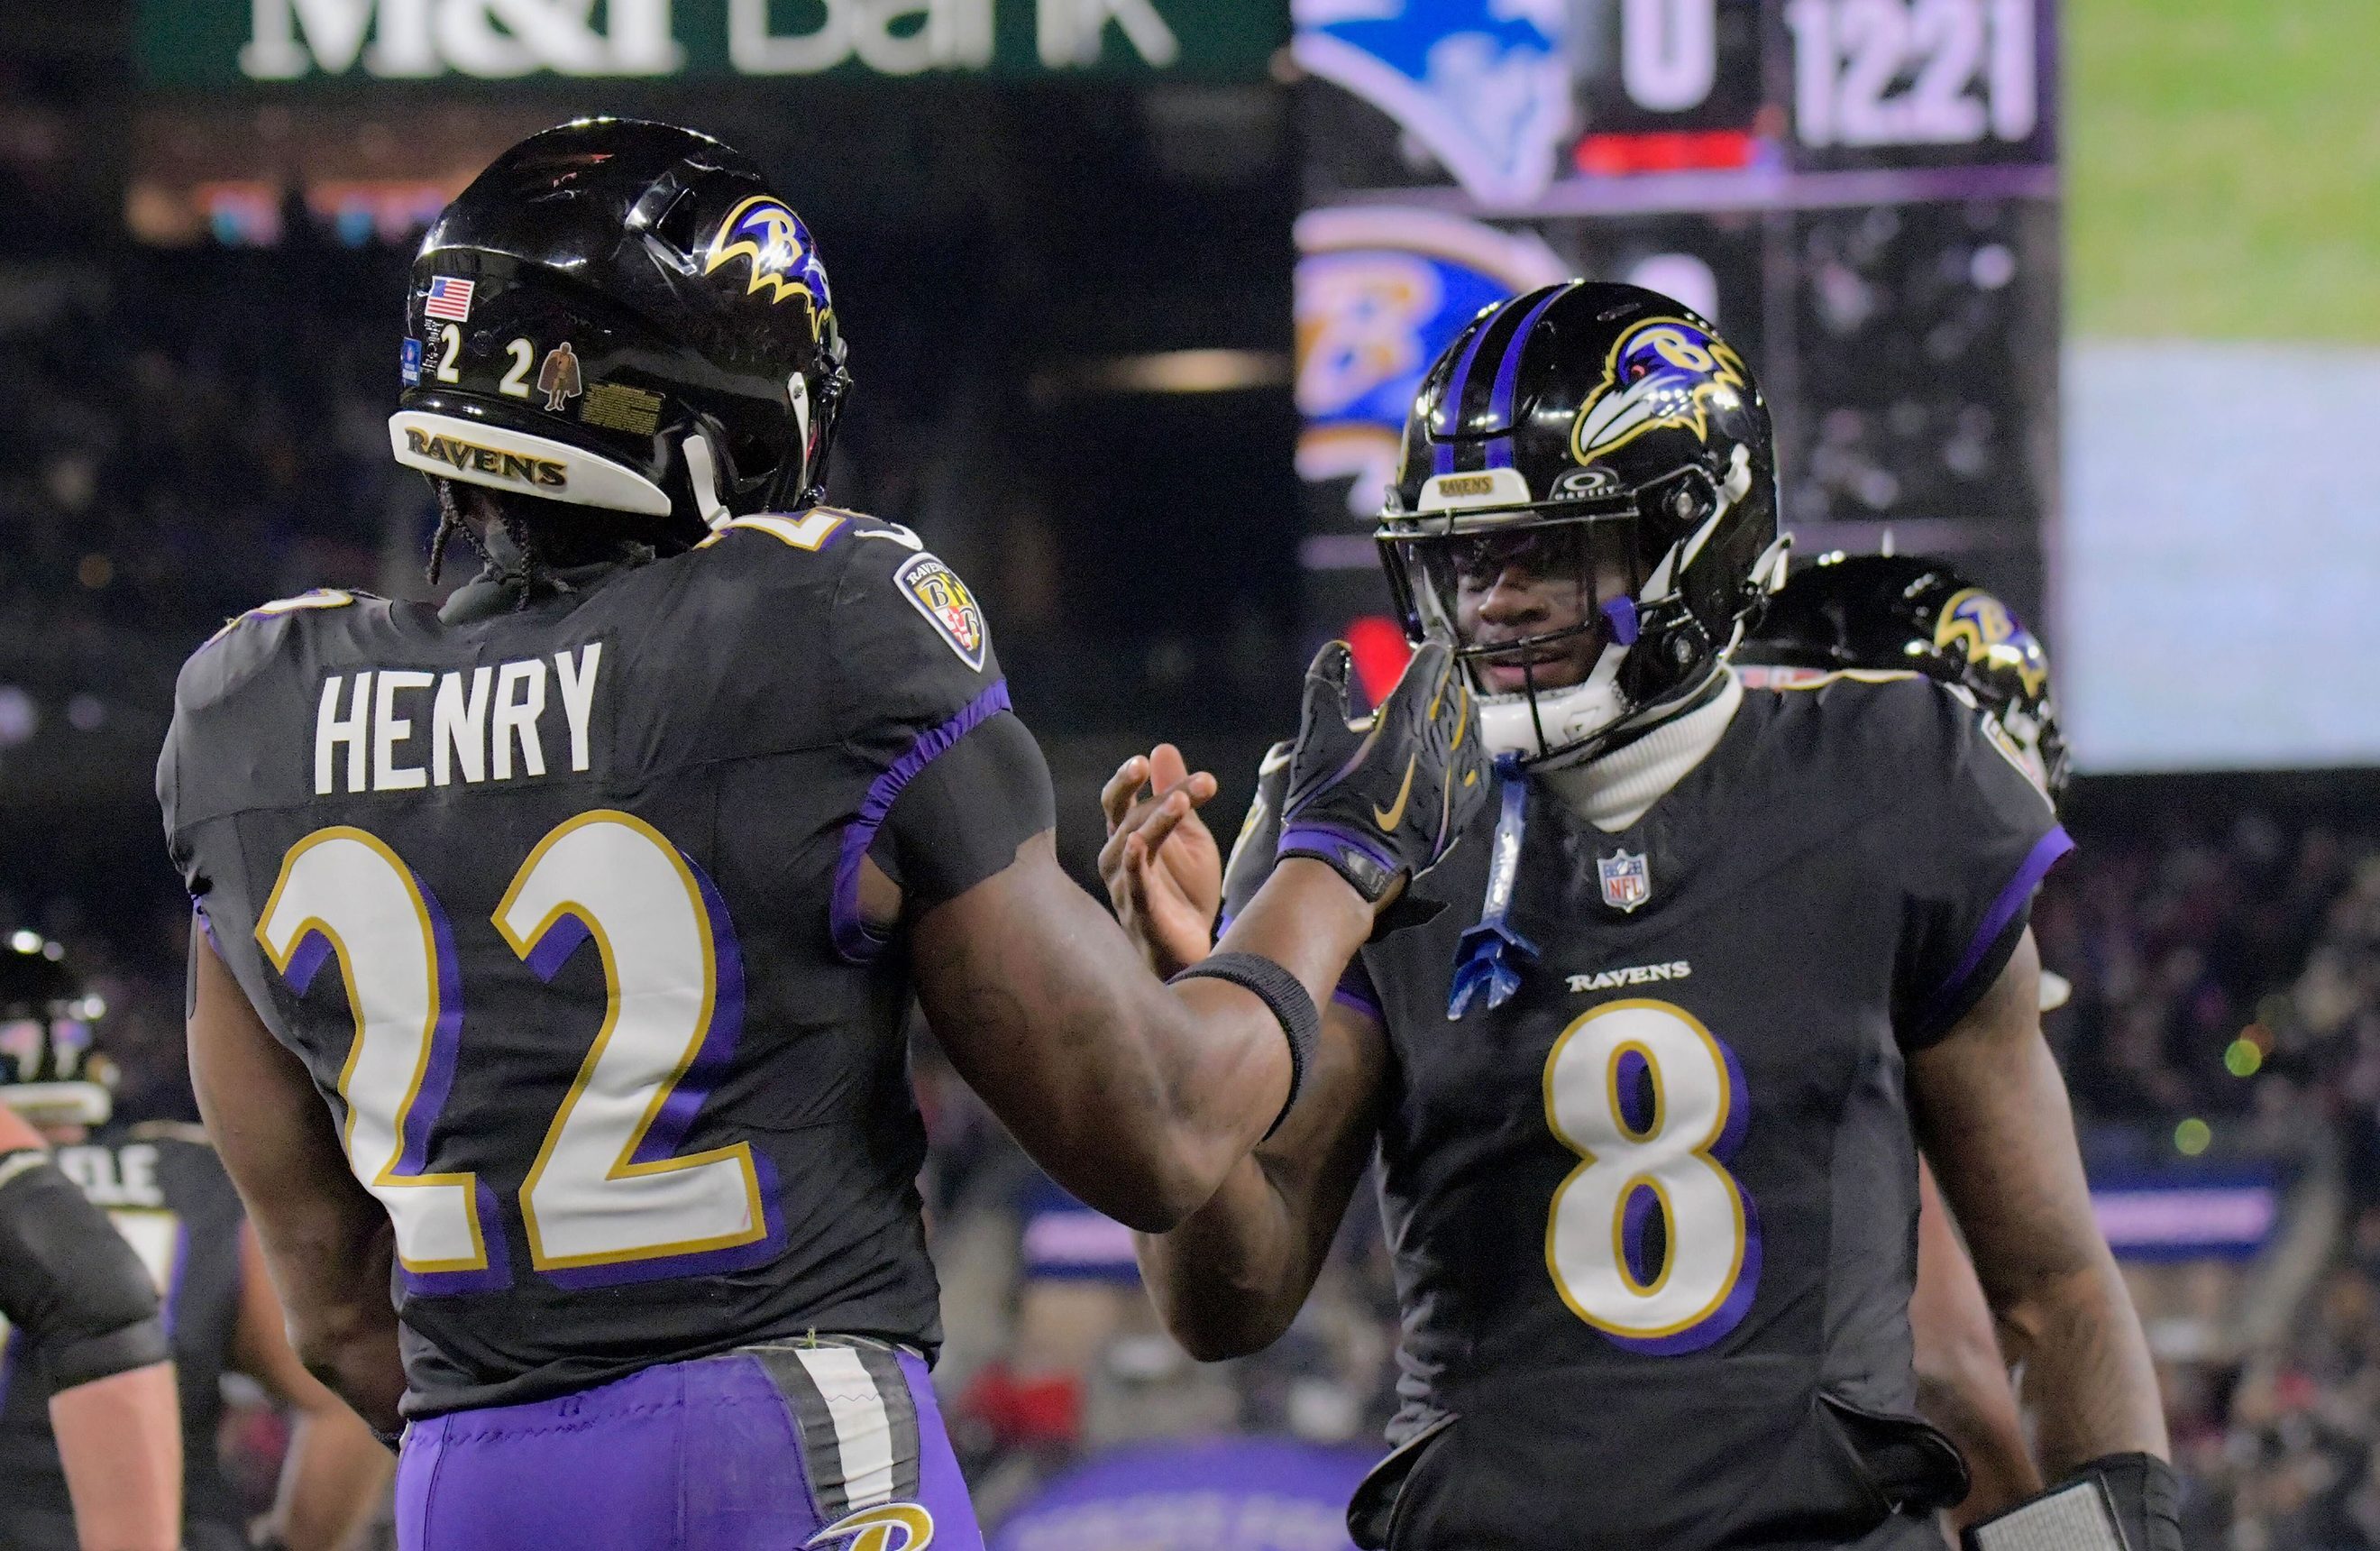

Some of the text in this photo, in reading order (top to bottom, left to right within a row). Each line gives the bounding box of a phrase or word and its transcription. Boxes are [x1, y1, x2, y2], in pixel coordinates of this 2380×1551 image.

[405, 426, 568, 488] RAVENS
[906, 562, 950, 586] RAVEN
[315, 641, 602, 795] HENRY
[1608, 876, 1643, 900] NFL
[1565, 960, 1692, 993] RAVENS
[255, 808, 769, 1273] 22
[1542, 998, 1747, 1339] 8
